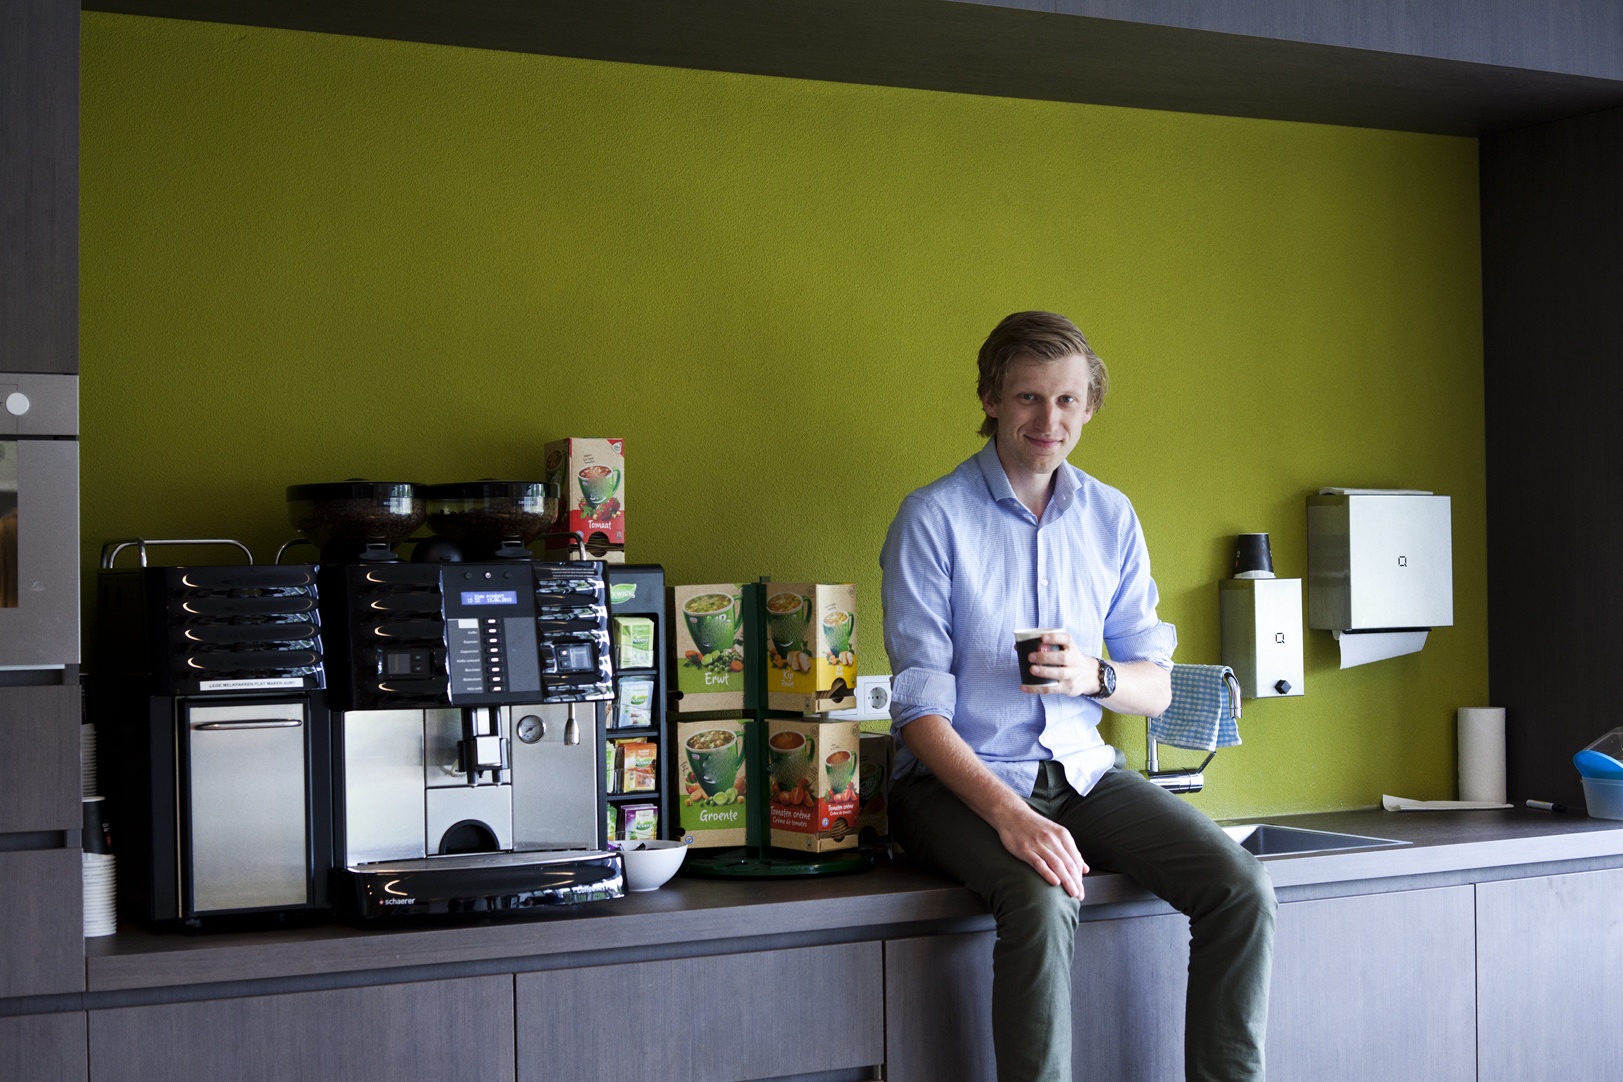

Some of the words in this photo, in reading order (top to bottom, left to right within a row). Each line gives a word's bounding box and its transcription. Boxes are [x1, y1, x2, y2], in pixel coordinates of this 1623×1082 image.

[588, 520, 612, 530] Tomaat
[1397, 555, 1407, 567] Q
[1275, 632, 1285, 644] Q
[705, 672, 729, 685] Erwt
[700, 809, 738, 822] Groente
[770, 806, 792, 818] Tomaten
[793, 810, 811, 820] crème
[773, 816, 786, 825] Crème
